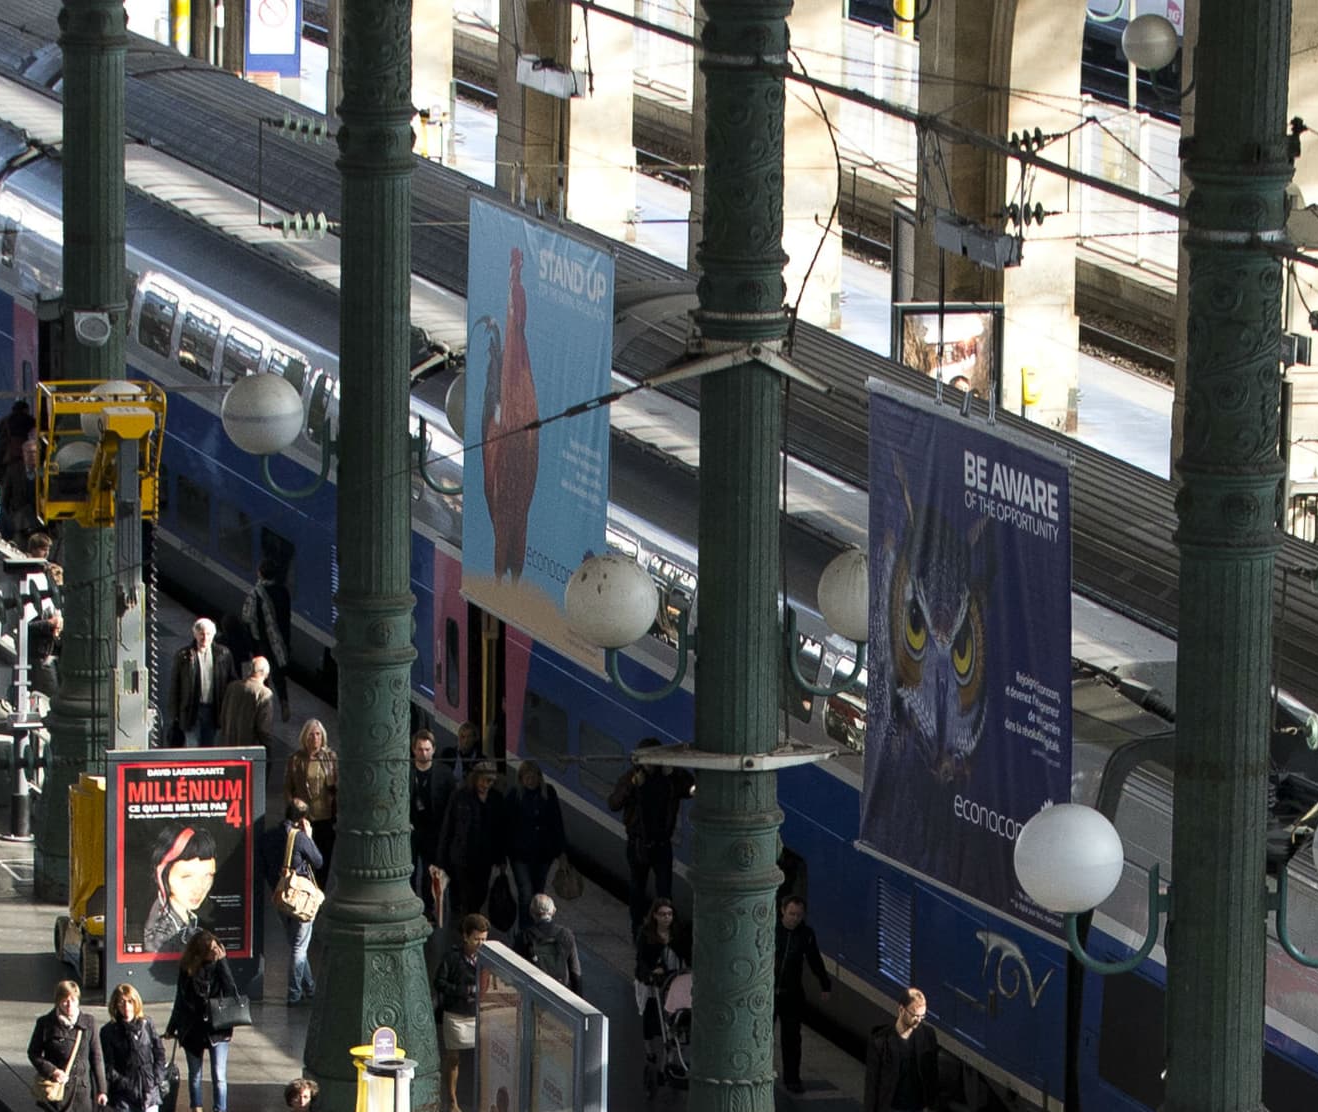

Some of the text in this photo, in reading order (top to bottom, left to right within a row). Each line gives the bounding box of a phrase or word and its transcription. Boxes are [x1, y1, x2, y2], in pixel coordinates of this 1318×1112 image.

[538, 248, 607, 304] STAND UP
[964, 450, 1059, 522] BE AWARE
[964, 490, 1059, 543] OF THE OPPORTUNITY
[127, 776, 243, 803] MILLÉNIUM
[128, 804, 141, 814] CE
[142, 804, 160, 814] QUI
[209, 802, 228, 812] PAS
[225, 800, 243, 828] 4
